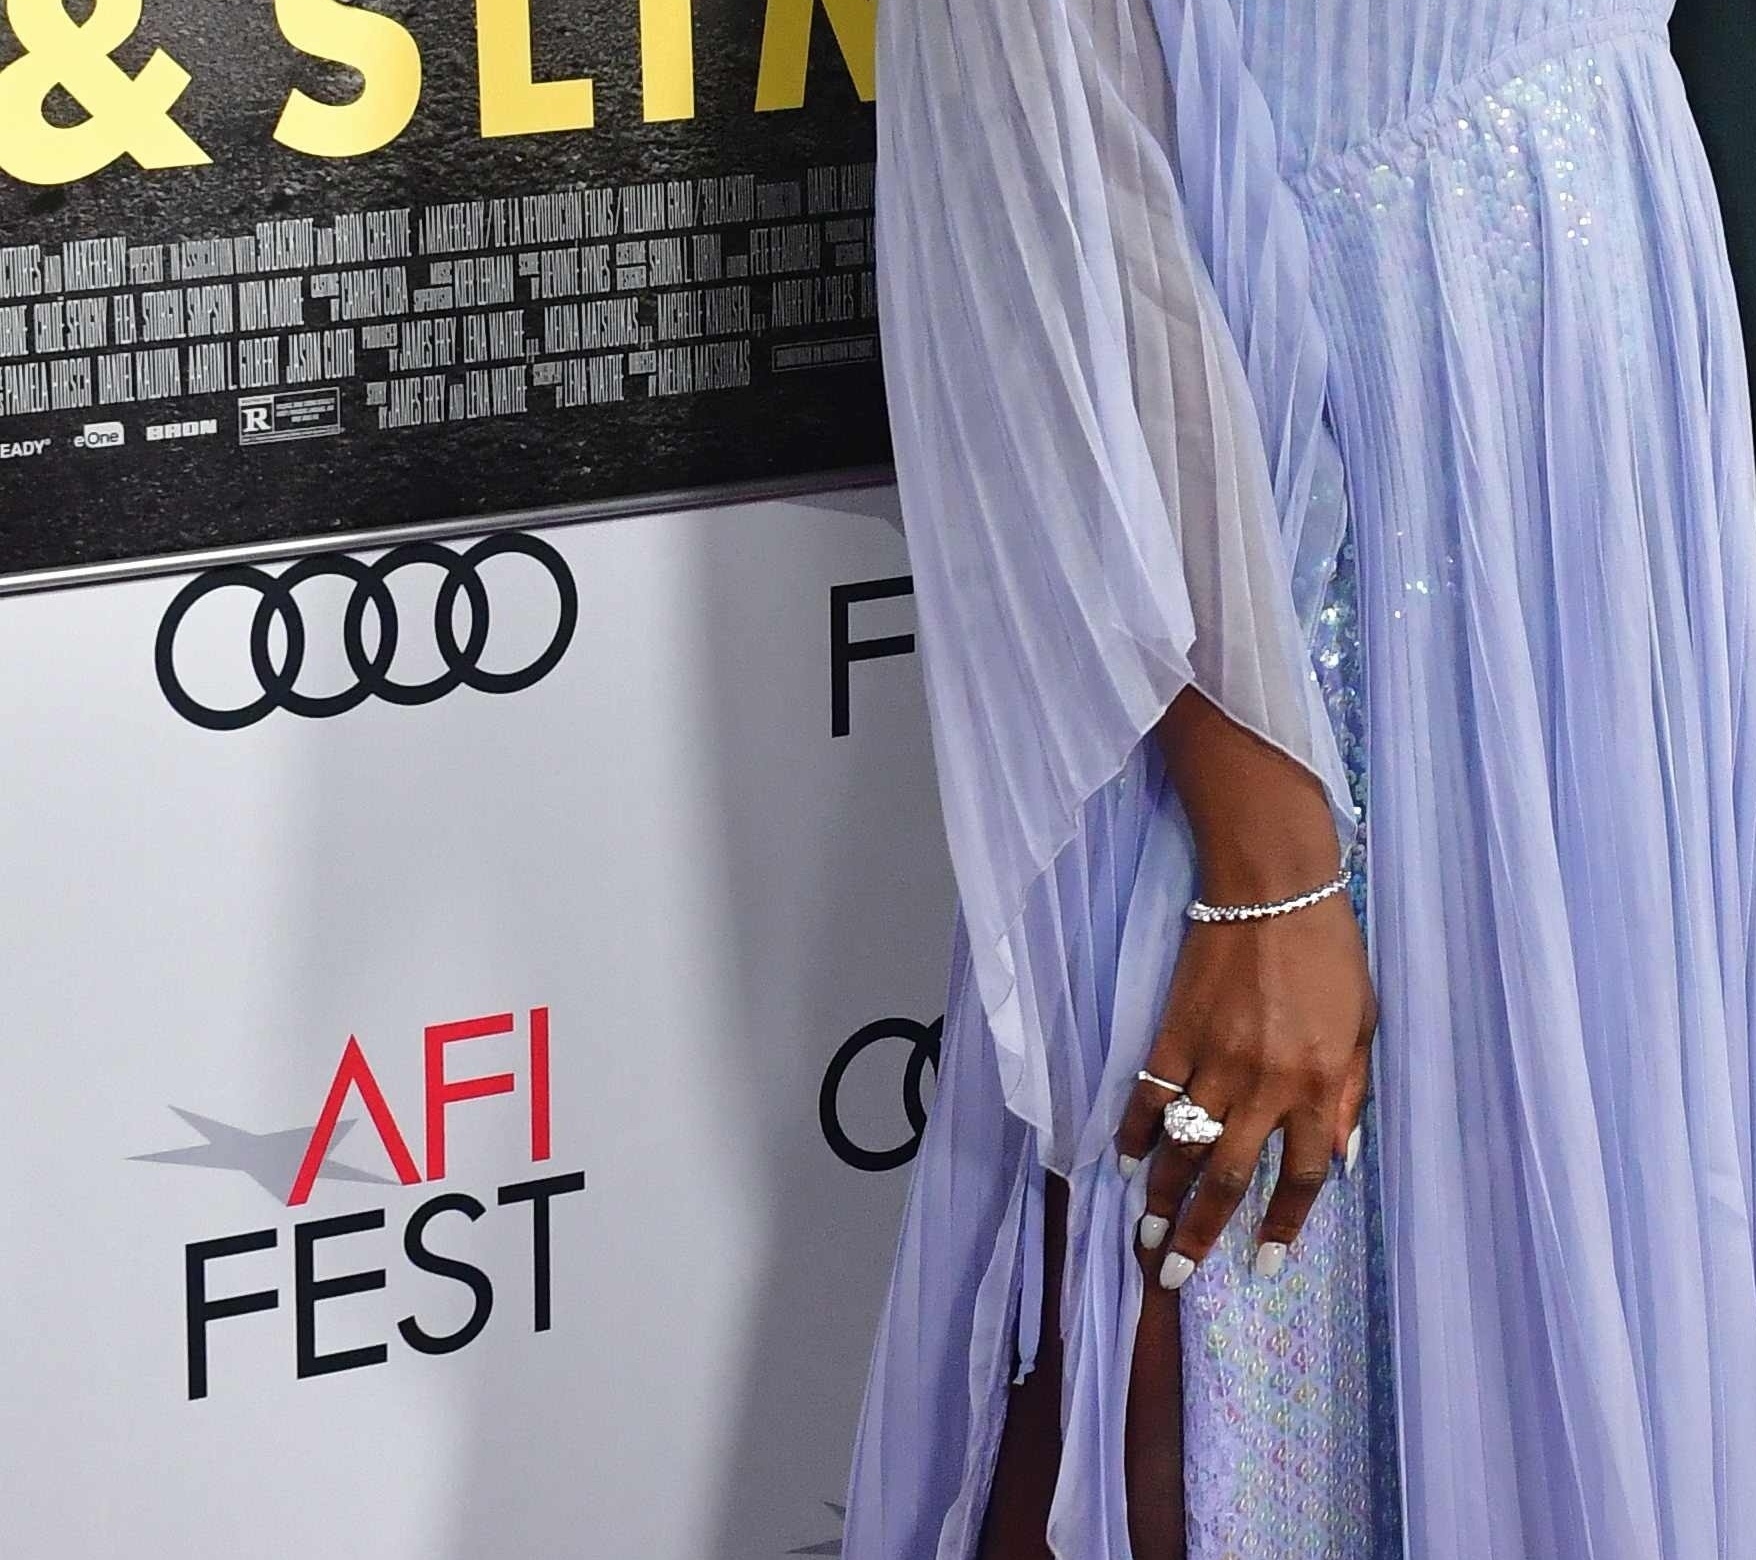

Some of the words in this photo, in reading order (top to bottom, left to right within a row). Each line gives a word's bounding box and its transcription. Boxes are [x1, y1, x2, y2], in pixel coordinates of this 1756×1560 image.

[63, 236, 127, 292] MAKEREADY
[335, 213, 365, 264] BRON
[366, 208, 412, 261] CREATIVE
[581, 244, 612, 294] HYNES
[113, 293, 138, 346] FLEA
[341, 268, 383, 321] CARMEN
[400, 319, 433, 371] JAMES
[433, 317, 458, 367] FREY
[462, 314, 488, 364] LENA
[488, 309, 526, 361] WAITHE
[5, 361, 50, 416] PAMELA
[98, 352, 136, 406] DANIEL
[239, 336, 279, 390] GILBERT
[286, 331, 323, 384] JASON
[323, 328, 356, 380] CLOTH
[388, 376, 422, 428] JAMES
[423, 373, 447, 423] FREY
[466, 369, 491, 419] LENA
[491, 364, 528, 416] WAITHE
[564, 358, 588, 408] LENA
[589, 353, 625, 404] WAITHE
[241, 406, 272, 433] R
[287, 1007, 551, 1207] AFI
[184, 1169, 586, 1401] FEST
